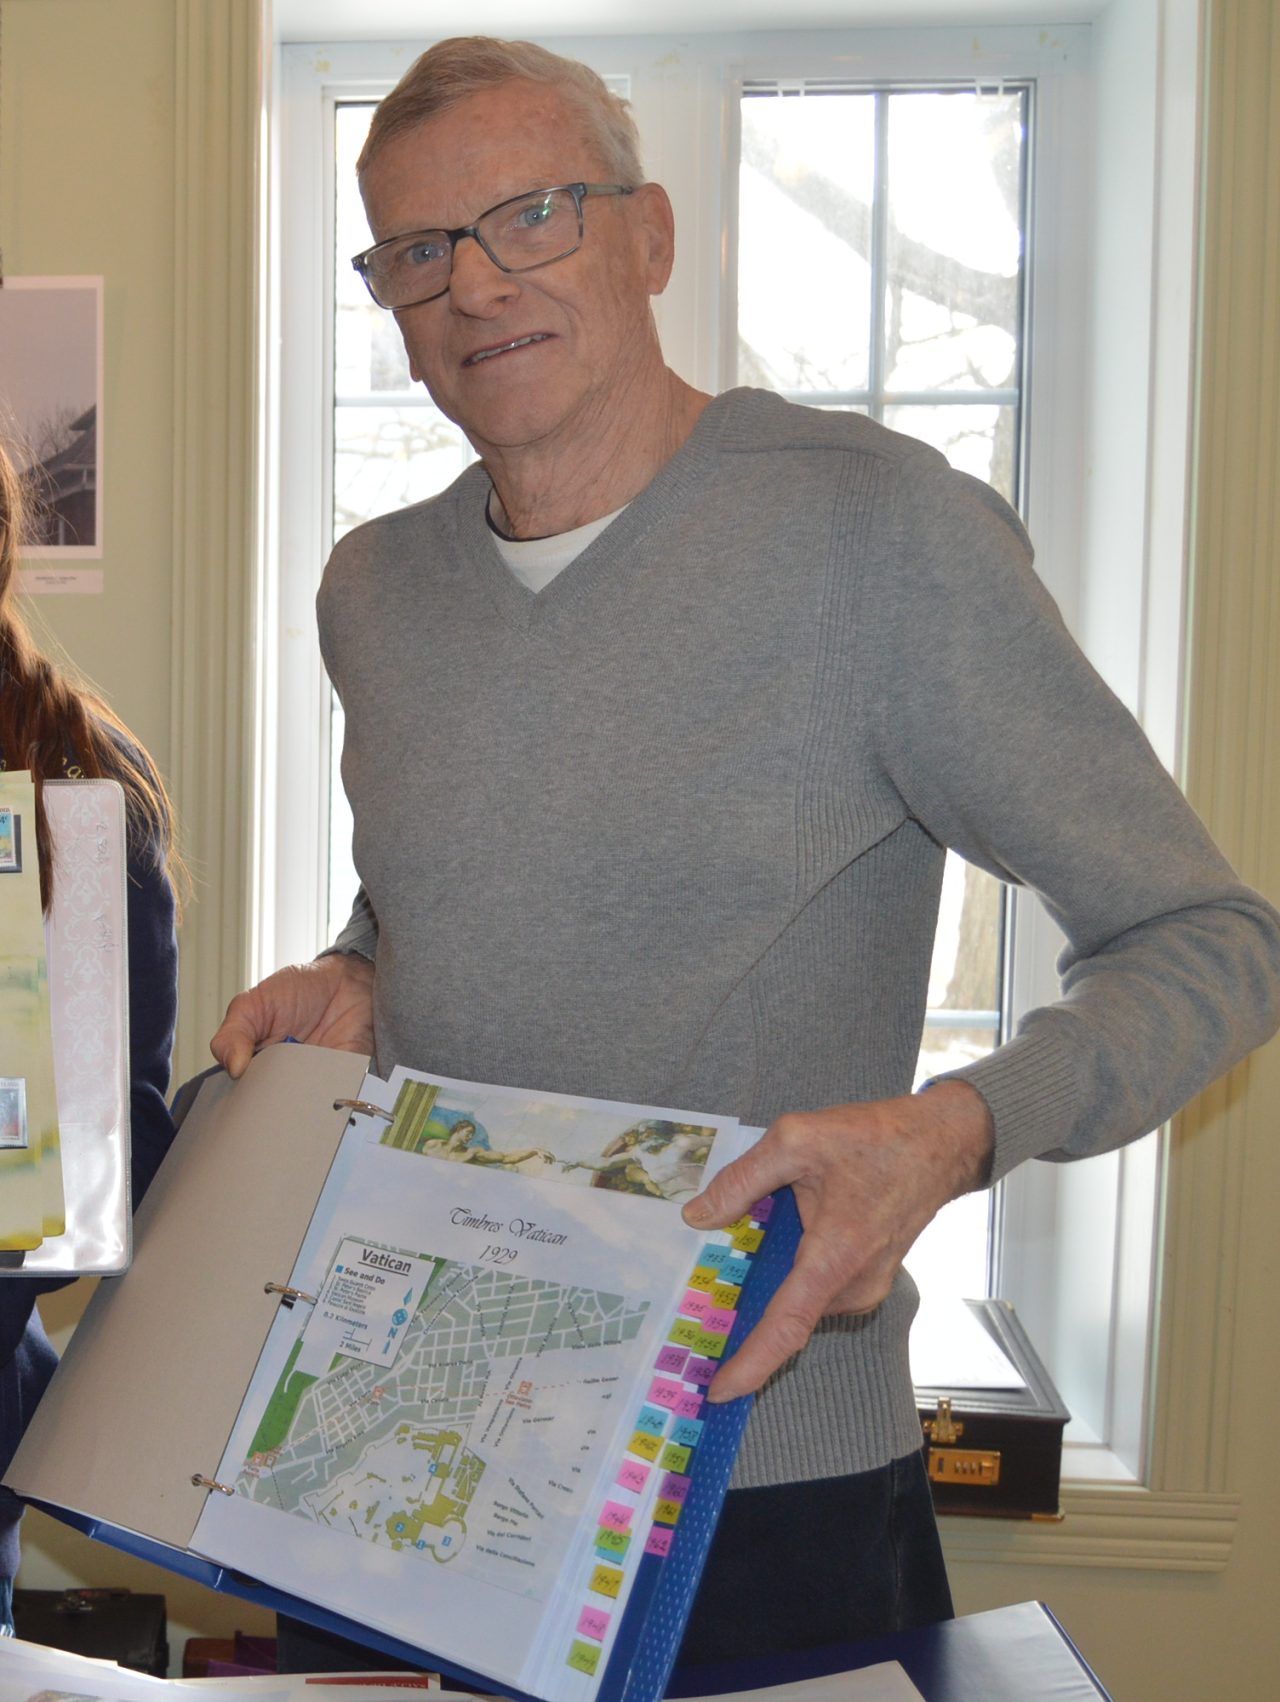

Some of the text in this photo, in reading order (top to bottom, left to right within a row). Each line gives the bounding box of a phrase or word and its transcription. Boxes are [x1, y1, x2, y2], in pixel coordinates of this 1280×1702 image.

[449, 1207, 568, 1246] Timbres Vatican
[361, 1248, 412, 1273] Vatican
[479, 1244, 518, 1265] 1929
[344, 1267, 386, 1285] See and Do
[345, 1342, 361, 1353] Miles
